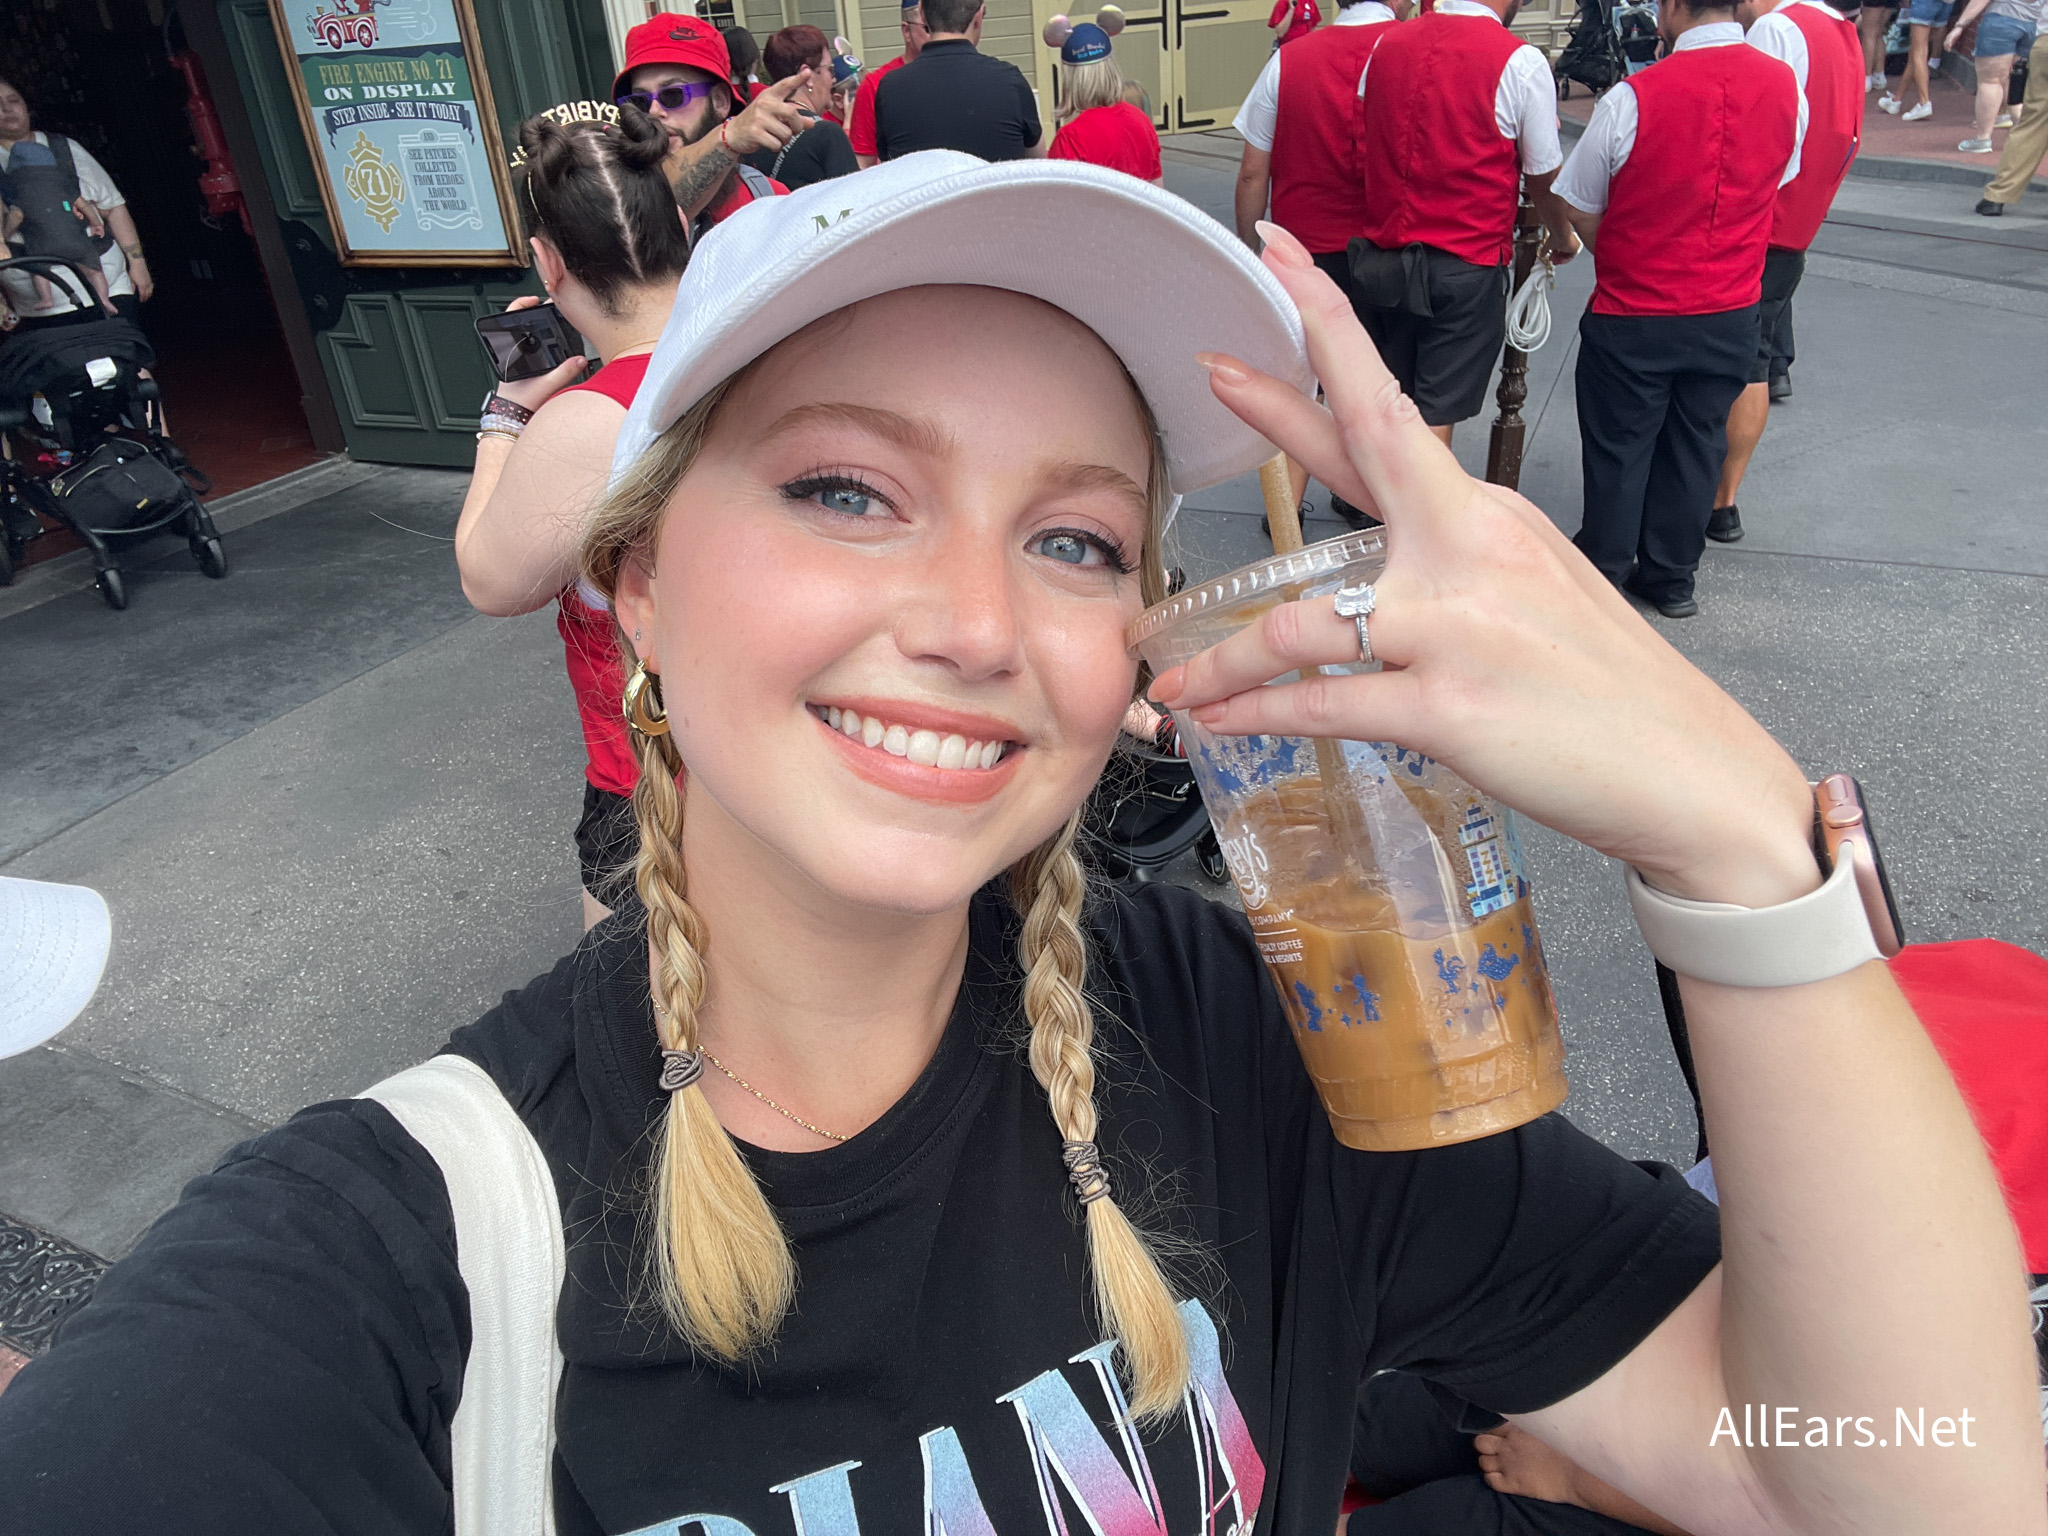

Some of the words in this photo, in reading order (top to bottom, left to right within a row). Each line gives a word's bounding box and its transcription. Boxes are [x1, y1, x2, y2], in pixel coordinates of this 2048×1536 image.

[319, 63, 352, 86] FIRE
[356, 61, 407, 84] ENGINE
[412, 60, 433, 81] NO.
[436, 58, 453, 80] 71
[324, 86, 353, 101] ON
[362, 82, 456, 99] DISPLAY
[332, 108, 354, 126] STEP
[357, 104, 390, 121] INSIDE
[396, 103, 415, 118] SEE
[416, 103, 427, 119] IT
[429, 104, 460, 122] TODAY
[423, 133, 435, 141] AND
[408, 149, 423, 160] SEE
[424, 148, 456, 160] PATCHES
[415, 161, 456, 172] COLLECTED
[360, 168, 389, 196] 71
[413, 175, 434, 186] FROM
[436, 174, 465, 185] HEROES
[428, 188, 457, 198] AROUND
[424, 201, 440, 210] THE
[442, 199, 467, 211] WORLD
[1277, 938, 1304, 951] COFFEE
